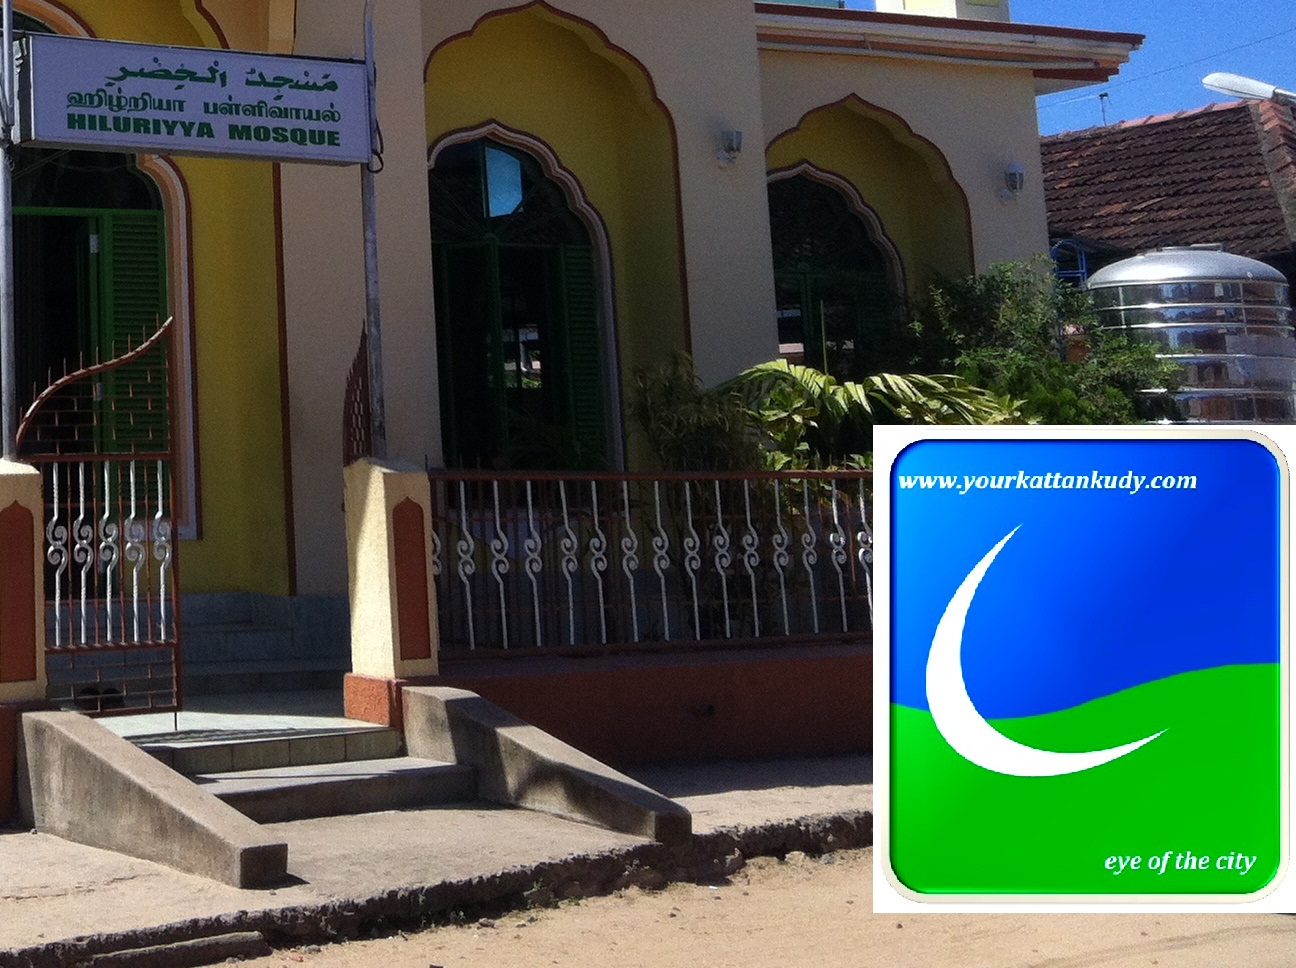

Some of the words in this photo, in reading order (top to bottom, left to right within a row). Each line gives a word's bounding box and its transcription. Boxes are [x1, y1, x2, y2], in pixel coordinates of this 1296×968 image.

[203, 94, 341, 123] பள்ளிவாயல்
[66, 113, 216, 138] HILURIYYA
[228, 123, 341, 147] MOSQUE
